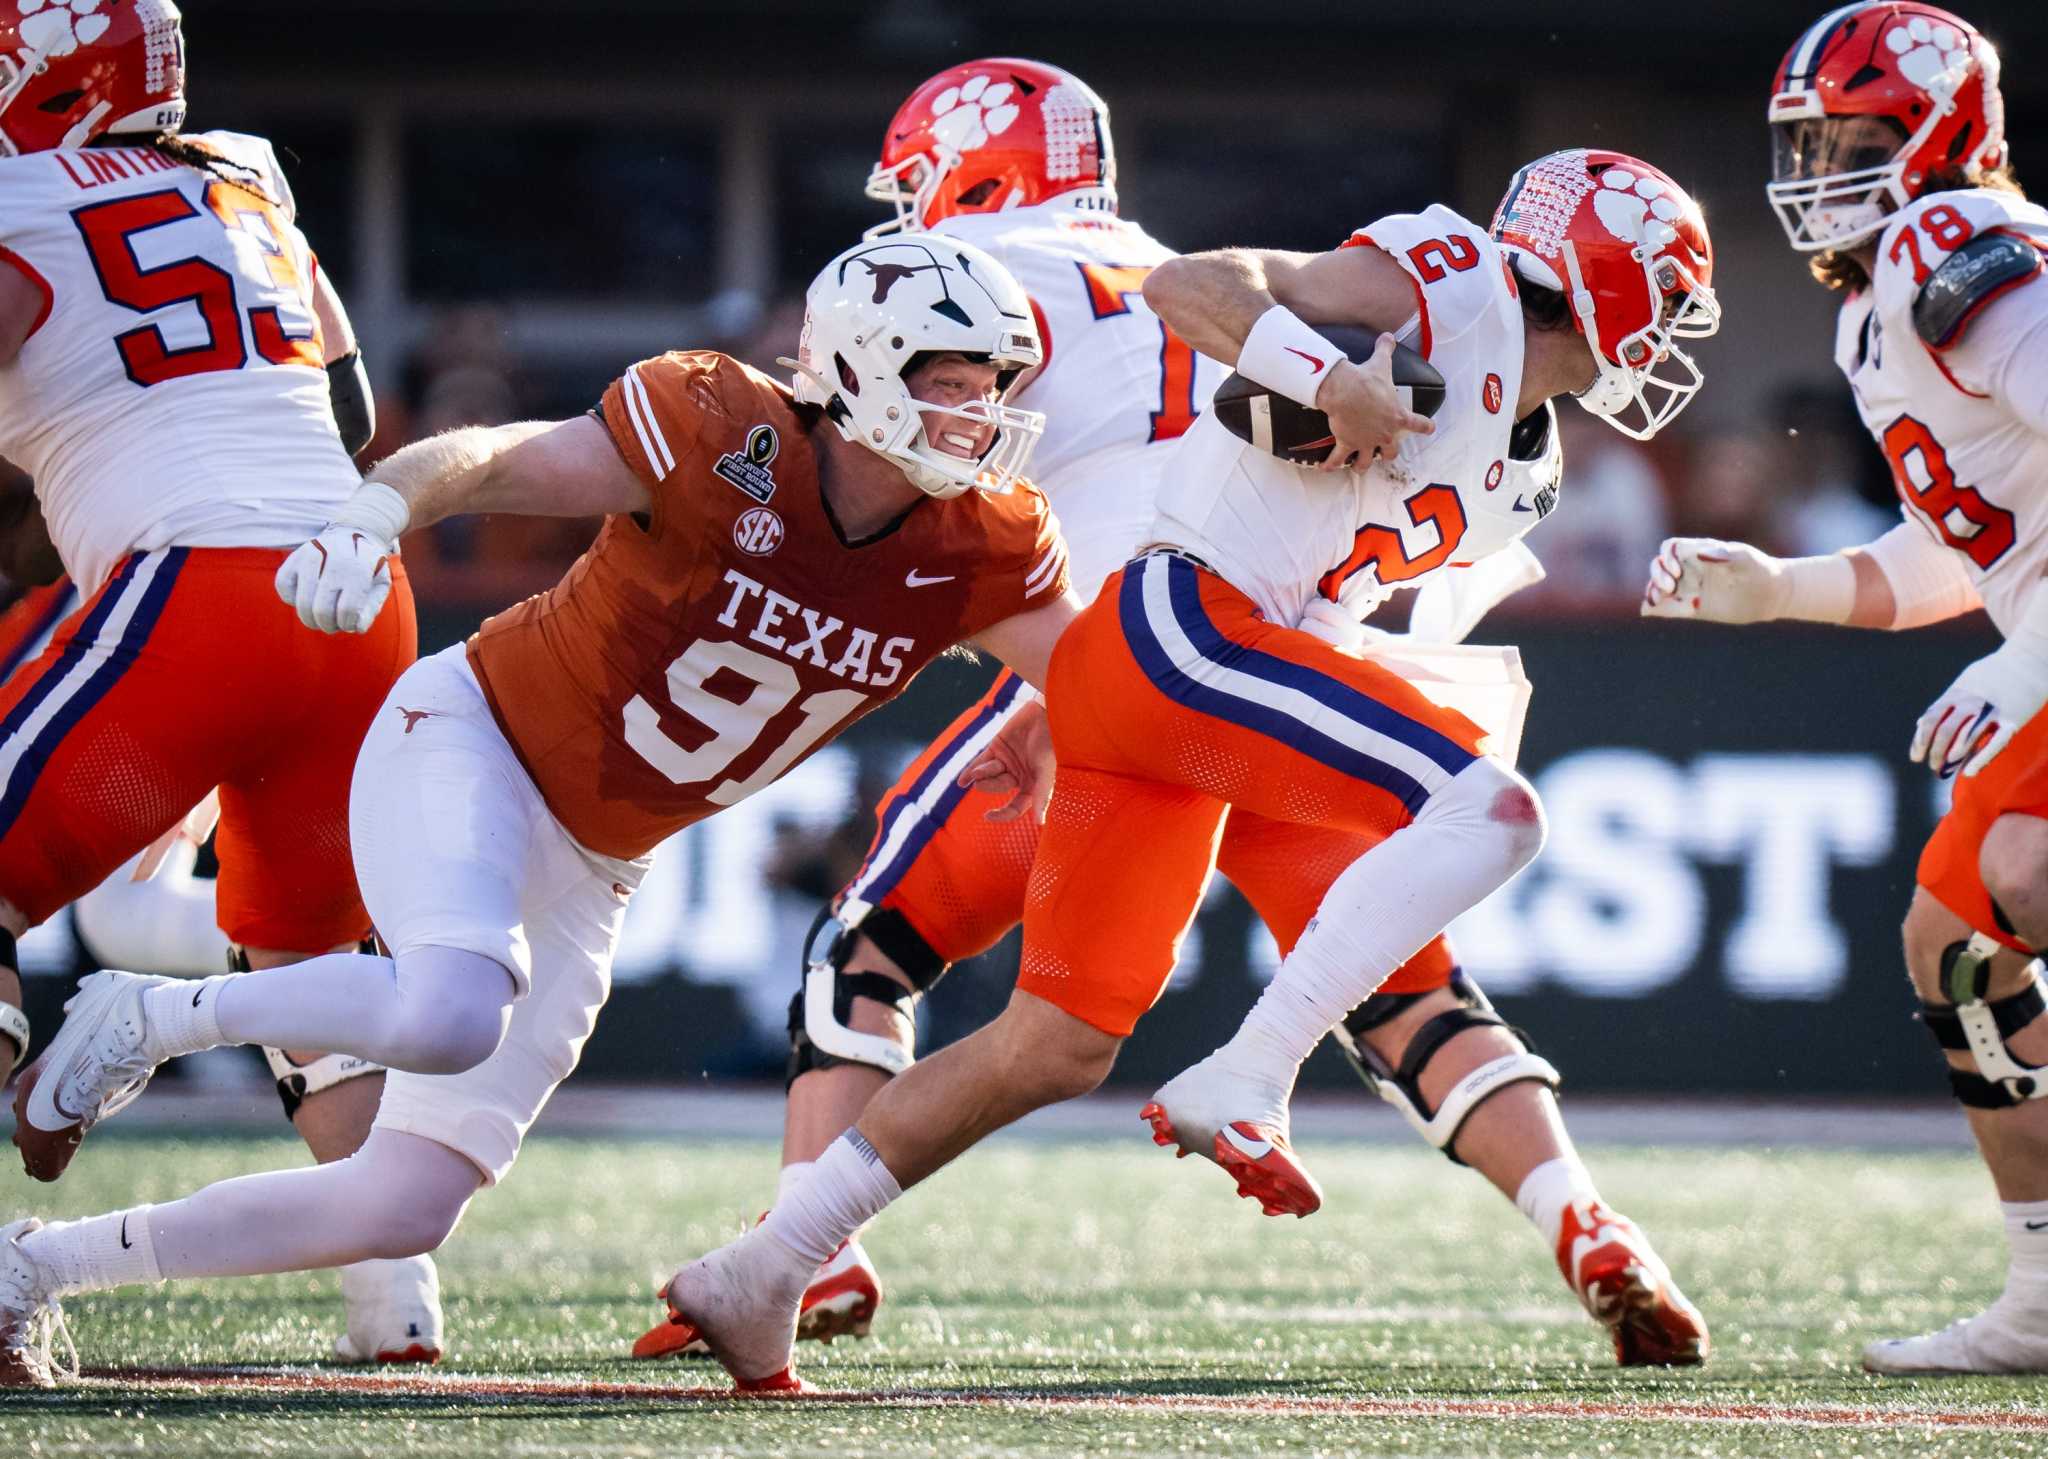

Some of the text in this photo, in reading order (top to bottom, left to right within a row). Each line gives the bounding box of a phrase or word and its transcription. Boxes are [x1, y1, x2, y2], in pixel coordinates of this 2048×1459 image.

[70, 178, 327, 389] 53
[1406, 234, 1480, 285] 2
[1888, 204, 1975, 286] 78
[722, 458, 747, 477] FIRST
[744, 471, 773, 494] ROUND
[735, 455, 769, 481] PLAYOFF
[737, 510, 781, 553] SEC
[1318, 481, 1468, 604] 2
[716, 568, 915, 688] TEXAS
[622, 637, 870, 806] 91
